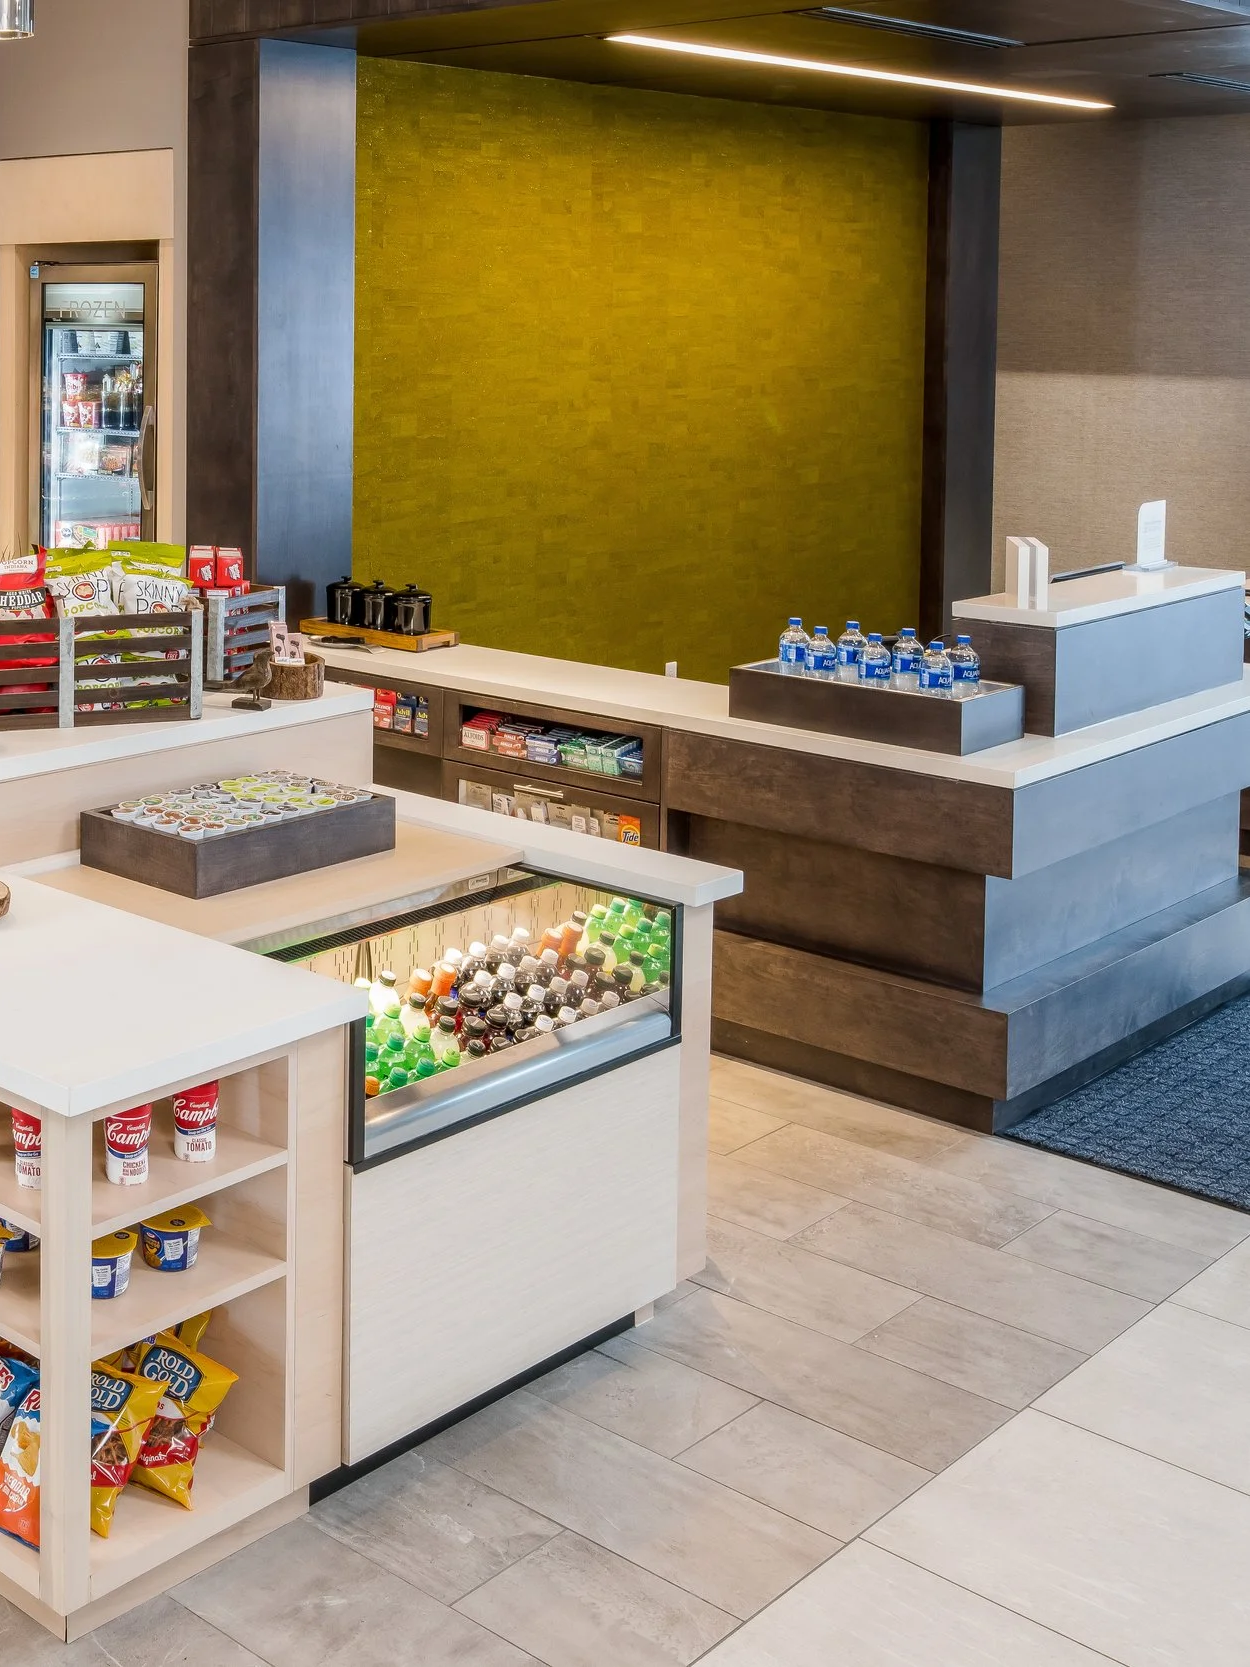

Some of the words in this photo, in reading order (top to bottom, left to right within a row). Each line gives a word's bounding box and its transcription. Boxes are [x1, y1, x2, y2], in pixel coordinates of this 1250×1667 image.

[60, 300, 126, 319] FROZEN
[137, 626, 183, 635] POPCOR
[396, 708, 410, 716] Advil
[622, 831, 639, 843] Tide
[186, 1141, 212, 1151] TOMATO
[17, 1162, 41, 1176] TOMATO
[157, 1348, 195, 1380] ROLD
[143, 1362, 189, 1398] GOLD
[91, 1386, 121, 1410] OLD
[140, 1453, 167, 1466] riginal
